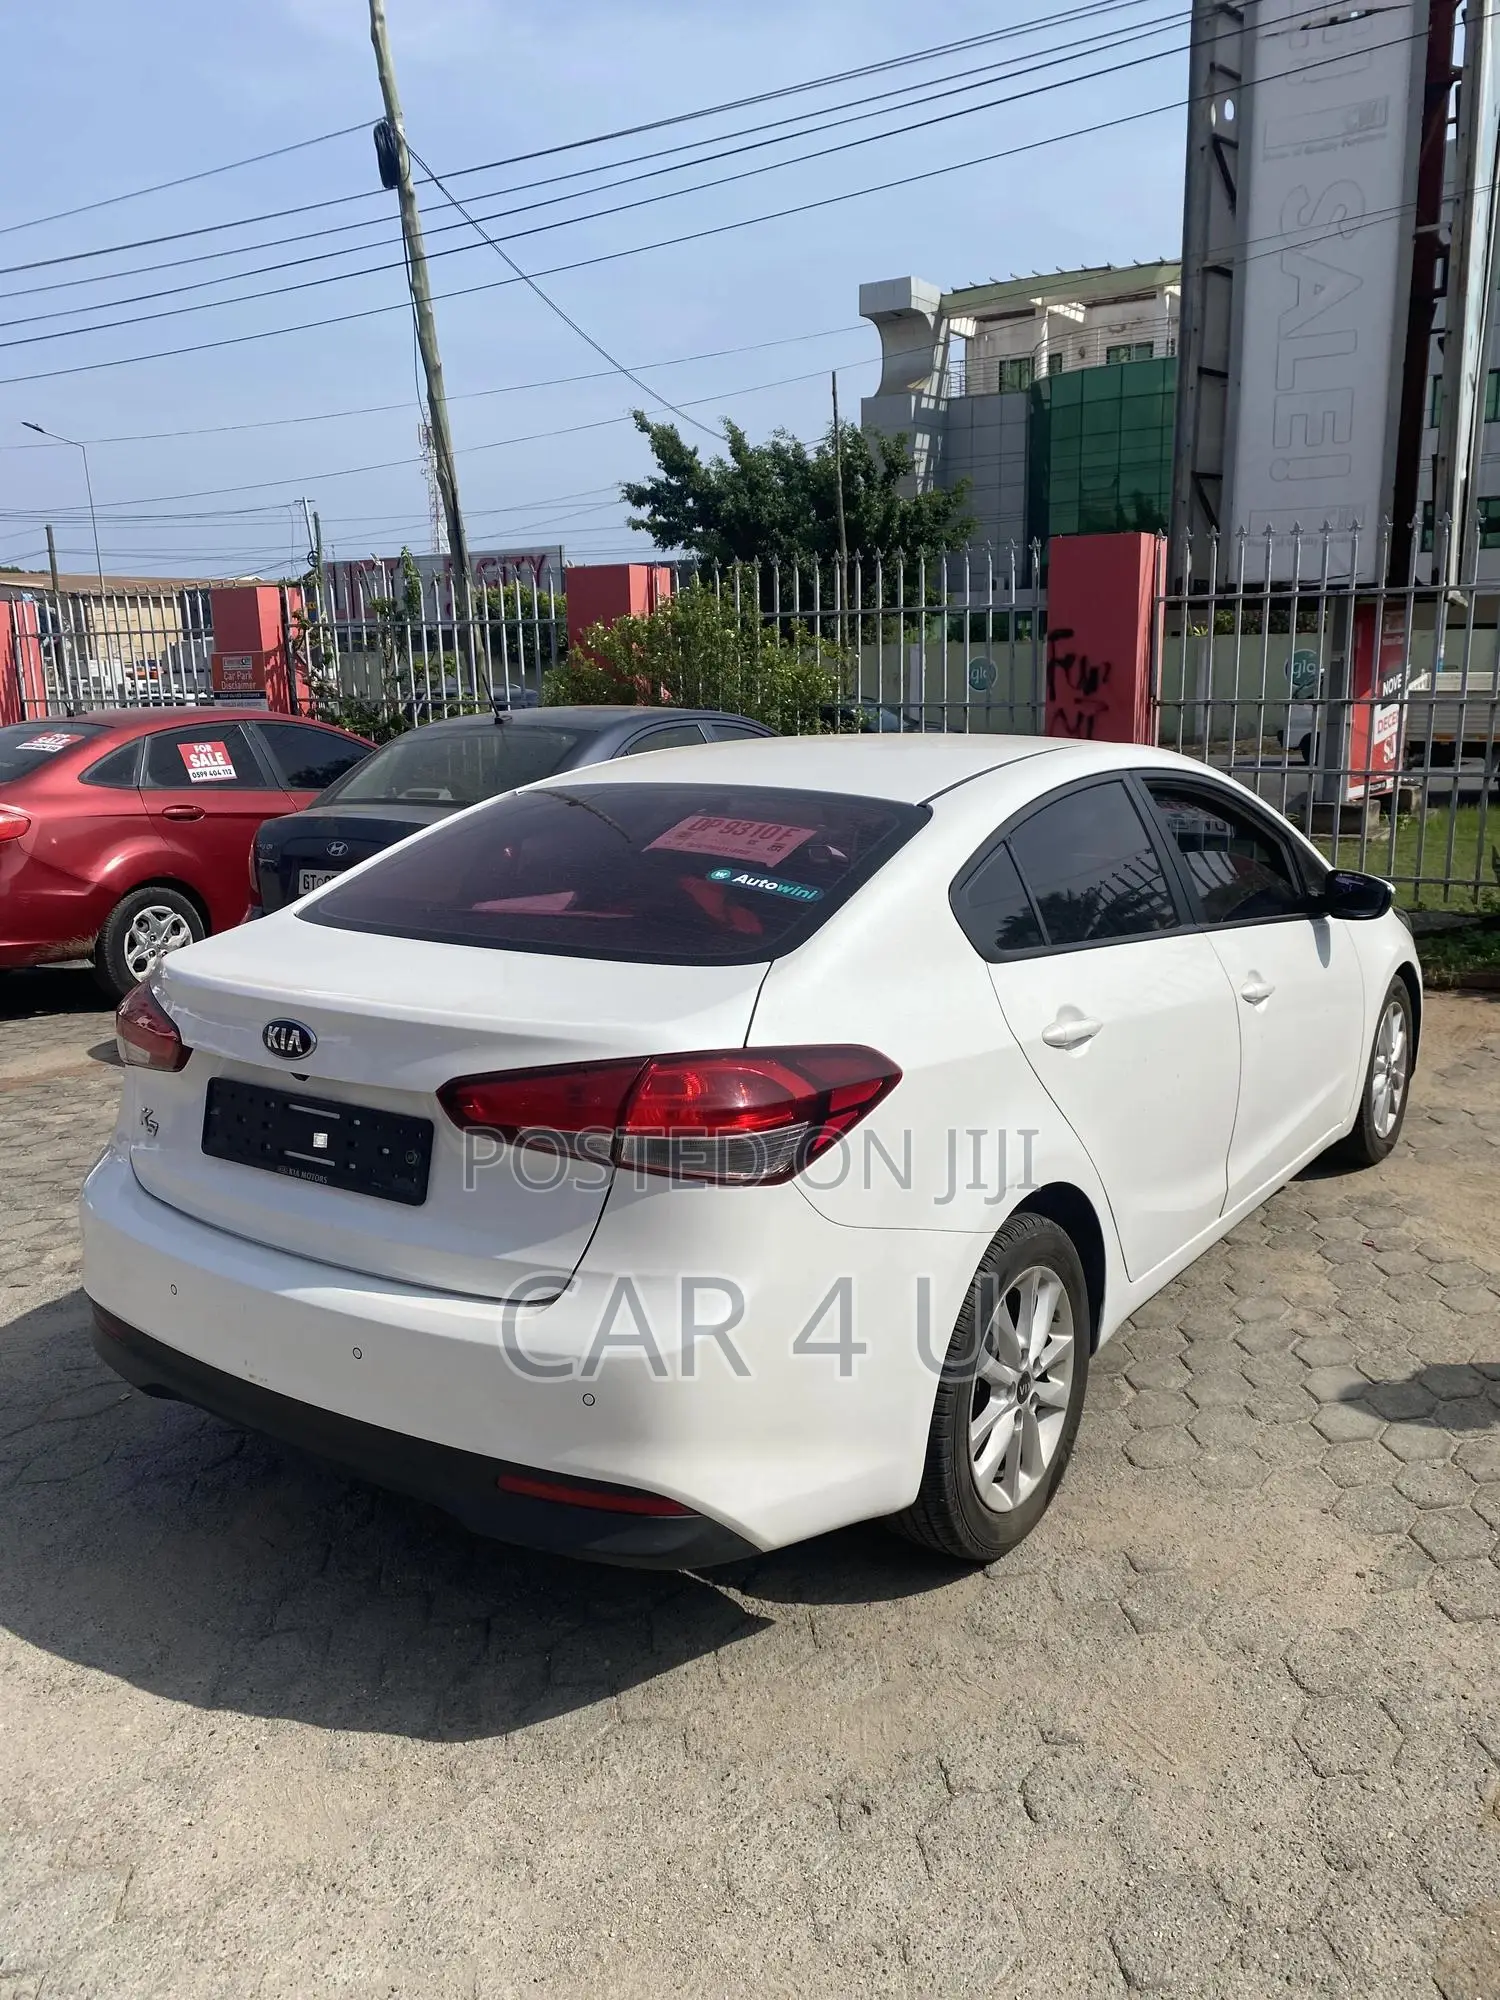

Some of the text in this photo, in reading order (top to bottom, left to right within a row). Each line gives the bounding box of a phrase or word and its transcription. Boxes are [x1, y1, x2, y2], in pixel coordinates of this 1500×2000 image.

[1270, 178, 1366, 484] SALE!
[223, 671, 253, 681] Car Park
[1293, 660, 1317, 679] glo
[221, 680, 257, 690] Disclaimer
[193, 744, 213, 754] FOR
[189, 751, 227, 768] SALE
[191, 770, 208, 779] 0599
[731, 874, 819, 900] Autowini
[266, 1025, 304, 1054] KIA
[288, 1167, 300, 1178] KIA
[300, 1171, 328, 1184] MOTORS
